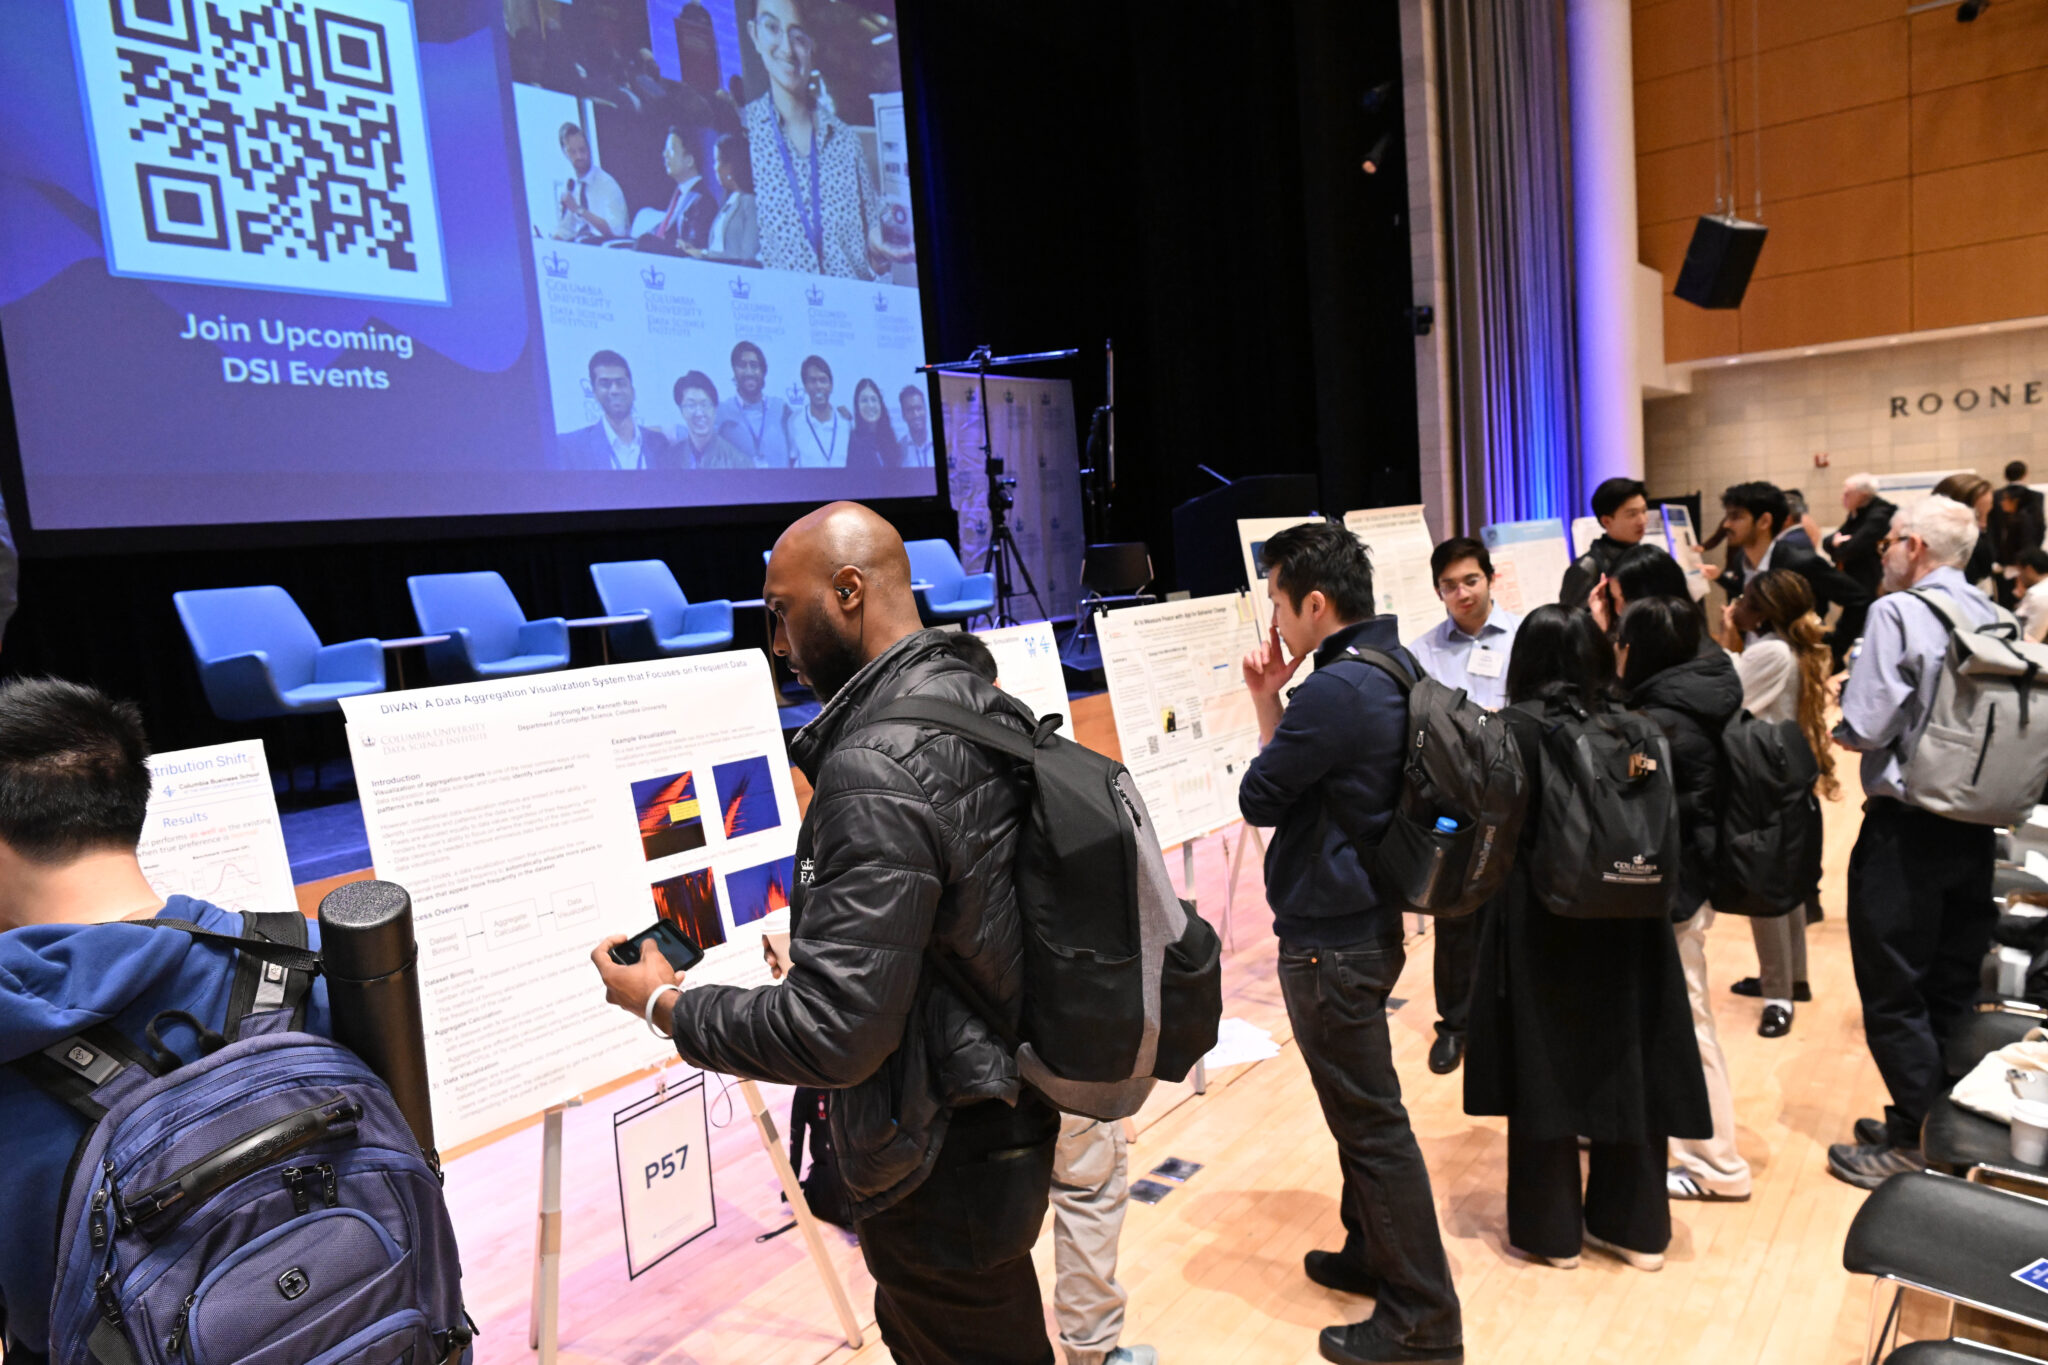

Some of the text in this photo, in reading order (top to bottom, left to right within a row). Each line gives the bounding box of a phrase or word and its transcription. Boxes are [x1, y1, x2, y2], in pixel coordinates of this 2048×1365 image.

[545, 278, 603, 296] COLUMBIA
[547, 291, 612, 309] UNIVERSITY
[644, 291, 696, 305] COLUMBIA
[645, 301, 703, 316] UNIVERSITY
[180, 313, 414, 359] Join Upcoming
[222, 357, 390, 389] DSI Events
[1890, 381, 2043, 418] ROONE
[380, 659, 748, 714] DIVAN: A Data Aggregation Visualization System that Focuses on Frequent Data
[623, 698, 638, 706] Ross
[518, 720, 552, 731] Department
[561, 714, 590, 725] Computer
[615, 707, 640, 717] Columbia
[380, 722, 487, 745] COLUMBIA UNIVERSITY
[611, 735, 637, 746] Example
[638, 728, 677, 741] Visualizations
[383, 732, 488, 755] DATA SCIENCE INSTITUTE
[152, 753, 248, 777] tribution Shift
[512, 769, 533, 780] identify
[534, 765, 562, 775] correlation
[179, 781, 208, 790] Columbia
[210, 776, 238, 784] Business
[371, 773, 421, 788] Introduction
[374, 771, 485, 797] Visualization of aggregation queries
[377, 802, 404, 814] patterns
[162, 812, 208, 828] Results
[151, 834, 187, 847] performs
[243, 818, 272, 828] existing
[160, 844, 176, 853] true
[178, 836, 220, 850] preference
[506, 860, 542, 873] automatically
[543, 853, 563, 863] allocate
[566, 849, 578, 857] more
[581, 846, 596, 855] pixels
[1613, 861, 1657, 871] COLUMBIA
[436, 890, 447, 898] that
[449, 885, 468, 896] appear
[487, 873, 516, 887] frequently
[567, 897, 582, 906] Data
[413, 902, 469, 922] cess Overview
[494, 912, 527, 928] Aggregate
[557, 904, 594, 919] Visualization
[429, 932, 457, 946] Dataset
[494, 922, 531, 938] Calculation
[432, 943, 459, 956] Binning
[424, 968, 474, 987] Dataset Binning
[434, 1009, 503, 1036] Aggregate Calculation
[443, 1076, 458, 1085] Data
[460, 1062, 499, 1079] Visualization
[645, 1144, 689, 1189] P57
